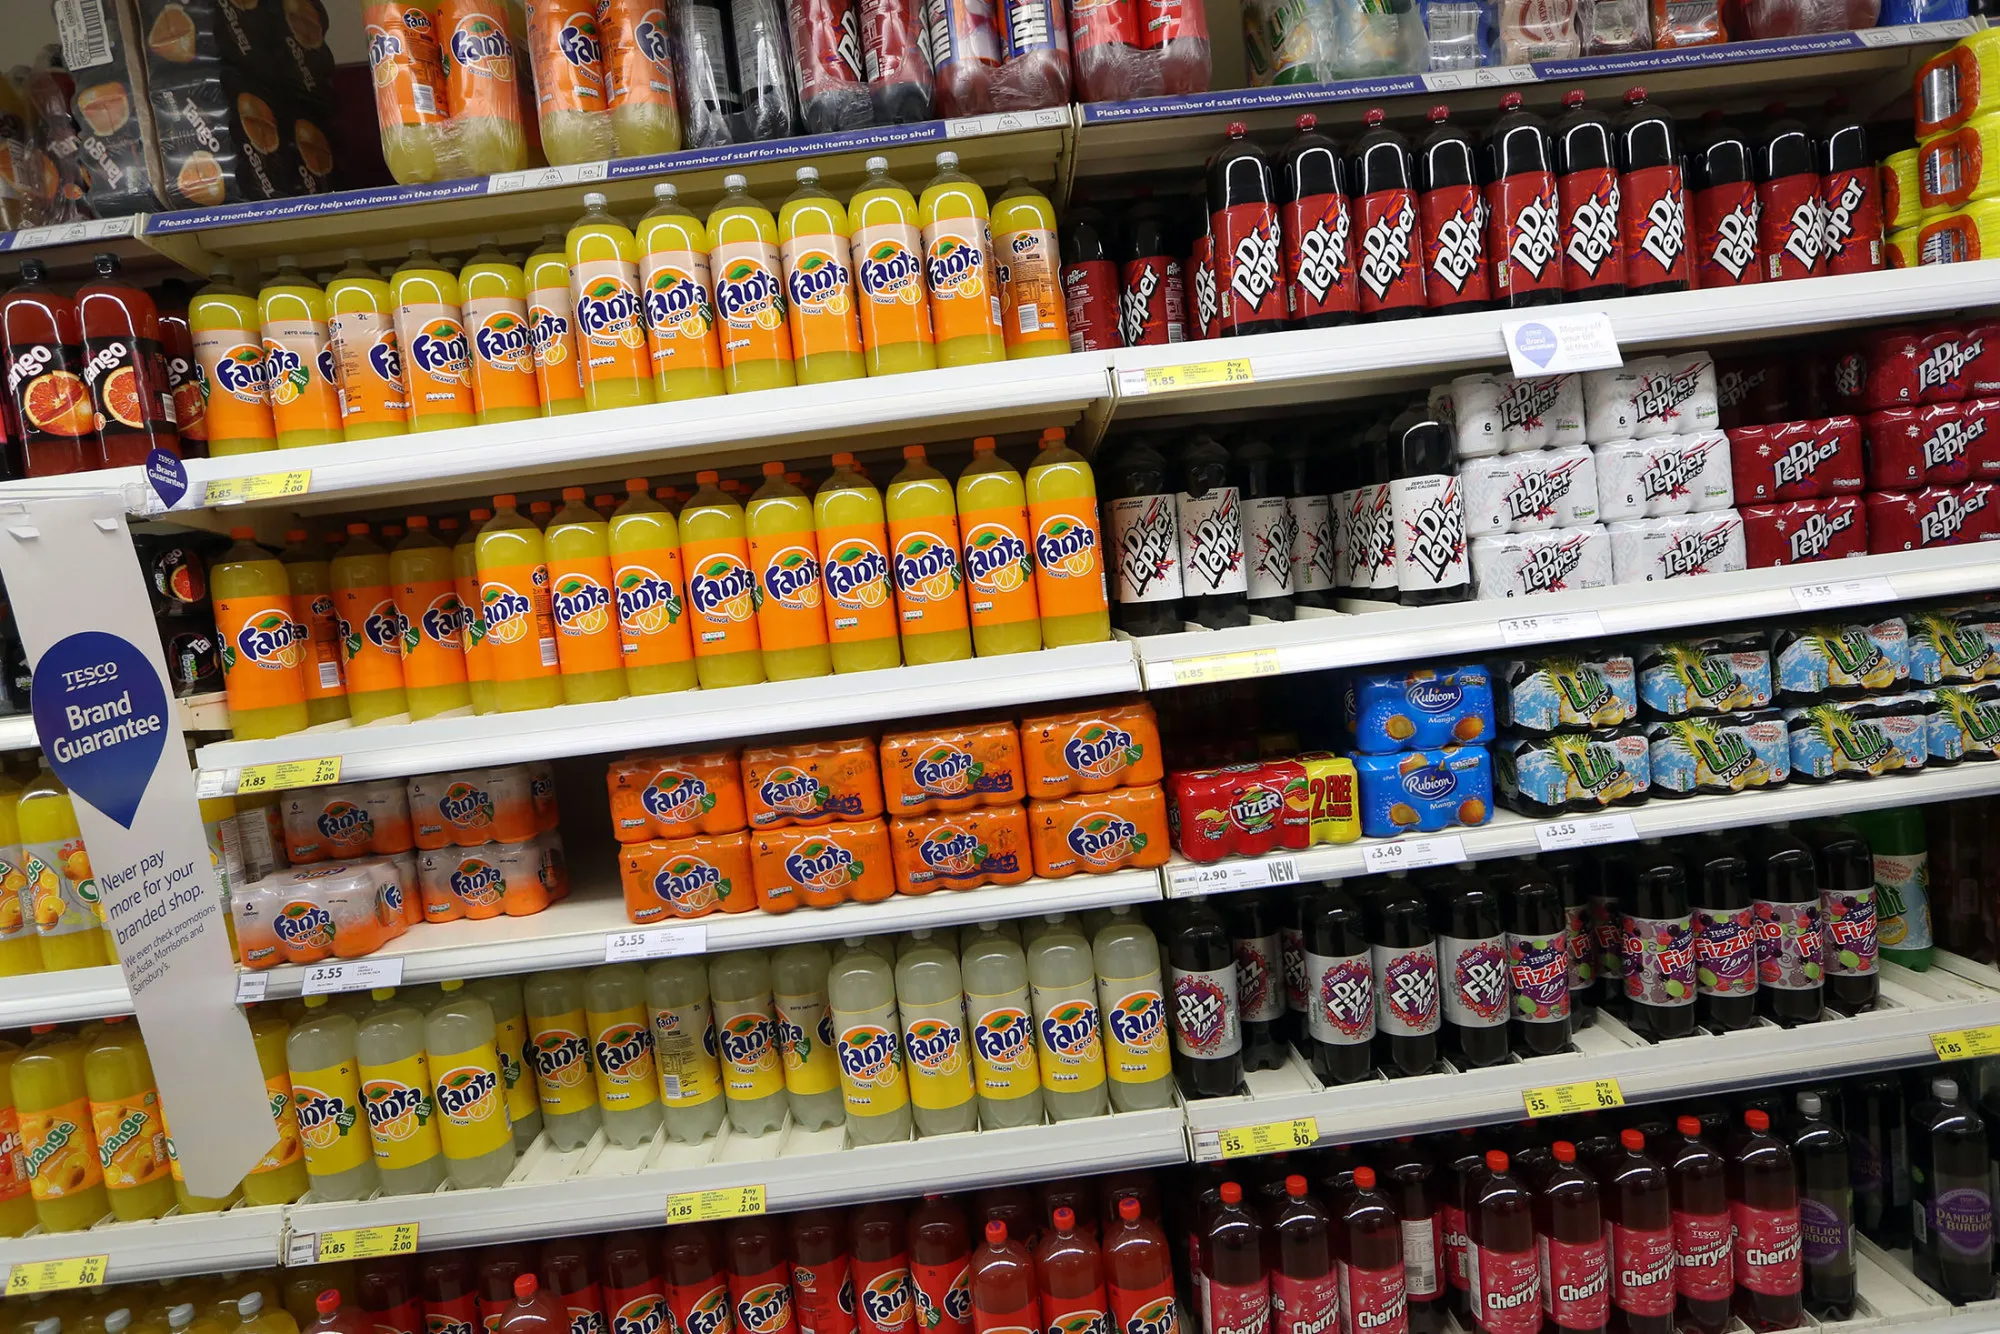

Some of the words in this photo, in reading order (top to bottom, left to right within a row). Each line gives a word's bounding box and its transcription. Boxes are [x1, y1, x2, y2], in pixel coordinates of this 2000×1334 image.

[451, 29, 513, 63] Fanta
[182, 98, 220, 152] Tango
[84, 137, 125, 189] Tango
[158, 219, 192, 228] Please
[193, 215, 211, 223] ask
[221, 209, 265, 221] member
[266, 208, 276, 216] of
[278, 204, 302, 214] staff
[302, 203, 319, 211] for
[320, 199, 343, 210] help
[344, 197, 367, 206] with
[369, 194, 397, 203] items
[414, 190, 432, 198] the
[433, 188, 451, 197] top
[452, 183, 480, 194] shelf
[1571, 193, 1604, 234] Dr
[1363, 216, 1388, 256] Dr
[1438, 210, 1469, 247] Dr
[1566, 178, 1621, 278] Pepper
[1012, 234, 1039, 252] Fanta
[1359, 198, 1416, 300] Pepper
[1434, 194, 1484, 293] Pepper
[860, 248, 922, 296] Fanta
[926, 245, 983, 293] Fanta
[948, 272, 968, 286] zero
[888, 278, 910, 292] zero
[577, 288, 643, 334] Fanta
[872, 296, 896, 304] ORANGE
[608, 319, 631, 333] zero
[591, 338, 617, 347] ORANGE
[1636, 372, 1698, 423] Pepper
[1651, 374, 1673, 397] Dr
[1674, 388, 1696, 404] zero
[1619, 416, 1625, 424] 6
[158, 454, 175, 464] TESCO
[1773, 437, 1840, 488] Pepper
[1789, 439, 1815, 461] Dr
[148, 469, 185, 489] Guarantee
[156, 464, 177, 479] Brand
[204, 489, 231, 499] £1.85
[279, 485, 303, 493] £2.00
[1757, 485, 1764, 494] 6
[964, 536, 1026, 581] Fanta
[1037, 526, 1095, 566] Fanta
[823, 552, 888, 599] Fanta
[691, 566, 756, 613] Fanta
[238, 621, 309, 661] Fanta
[62, 661, 118, 685] TESCO
[1685, 659, 1736, 698] Lilt
[1557, 668, 1606, 712] Lilt
[1711, 683, 1737, 705] zero
[65, 690, 133, 732] Brand
[1583, 694, 1608, 720] zero
[53, 714, 161, 764] Guarantee
[1064, 729, 1132, 770] Fanta
[240, 777, 266, 787] £1.85
[312, 773, 335, 782] £2.00
[913, 750, 974, 788] Fanta
[641, 778, 706, 816] Fanta
[1326, 775, 1352, 802] FREE
[1407, 776, 1453, 792] Rubicon
[1232, 793, 1280, 820] TiZER
[1310, 778, 1326, 820] 2
[1326, 803, 1352, 817] CANS
[1429, 800, 1456, 810] Mango
[1067, 820, 1136, 858] Fanta
[1546, 823, 1577, 838] £3.55
[785, 846, 852, 884] Fanta
[1371, 845, 1403, 859] £3.49
[101, 864, 137, 895] Never
[140, 850, 165, 876] pay
[654, 865, 721, 901] Fanta
[1198, 868, 1228, 882] £2.90
[1267, 859, 1294, 883] NEW
[110, 891, 142, 920] more
[143, 879, 161, 898] for
[164, 861, 195, 891] your
[116, 899, 167, 945] branded
[168, 885, 204, 911] shop.
[245, 901, 253, 911] 6
[124, 955, 136, 968] We
[136, 944, 153, 960] even
[153, 928, 174, 947] check
[174, 904, 216, 935] promotions
[273, 906, 330, 941] Fanta
[298, 928, 317, 941] zero
[1709, 927, 1734, 937] TESCO
[130, 973, 137, 982] at
[137, 958, 155, 976] Asda,
[154, 933, 189, 960] Morrisons
[190, 923, 205, 938] and
[613, 933, 646, 948] £3.55
[1695, 929, 1755, 961] Fizzio
[311, 967, 343, 981] £3.55
[1390, 960, 1410, 976] TESCO
[1719, 953, 1749, 973] Zero
[132, 960, 171, 995] Sainsbury's.
[1396, 969, 1422, 992] Dr
[1391, 967, 1437, 1015] Fizz
[1415, 988, 1436, 1014] Zero
[838, 1032, 898, 1076] Fanta
[905, 1025, 962, 1069] Fanta
[929, 1051, 949, 1065] zero
[865, 1061, 886, 1076] zero
[917, 1068, 937, 1077] LEMON
[435, 1070, 497, 1115] Fanta
[852, 1080, 872, 1088] LEMON
[450, 1118, 469, 1126] LEMON
[26, 1120, 76, 1179] Orange
[100, 1111, 149, 1167] Orange
[668, 1206, 692, 1217] £1.85
[738, 1203, 760, 1213] £2.00
[320, 1244, 345, 1255] £1.85
[390, 1242, 411, 1251] £2.00
[1690, 1243, 1709, 1252] sugar
[1710, 1238, 1723, 1248] free
